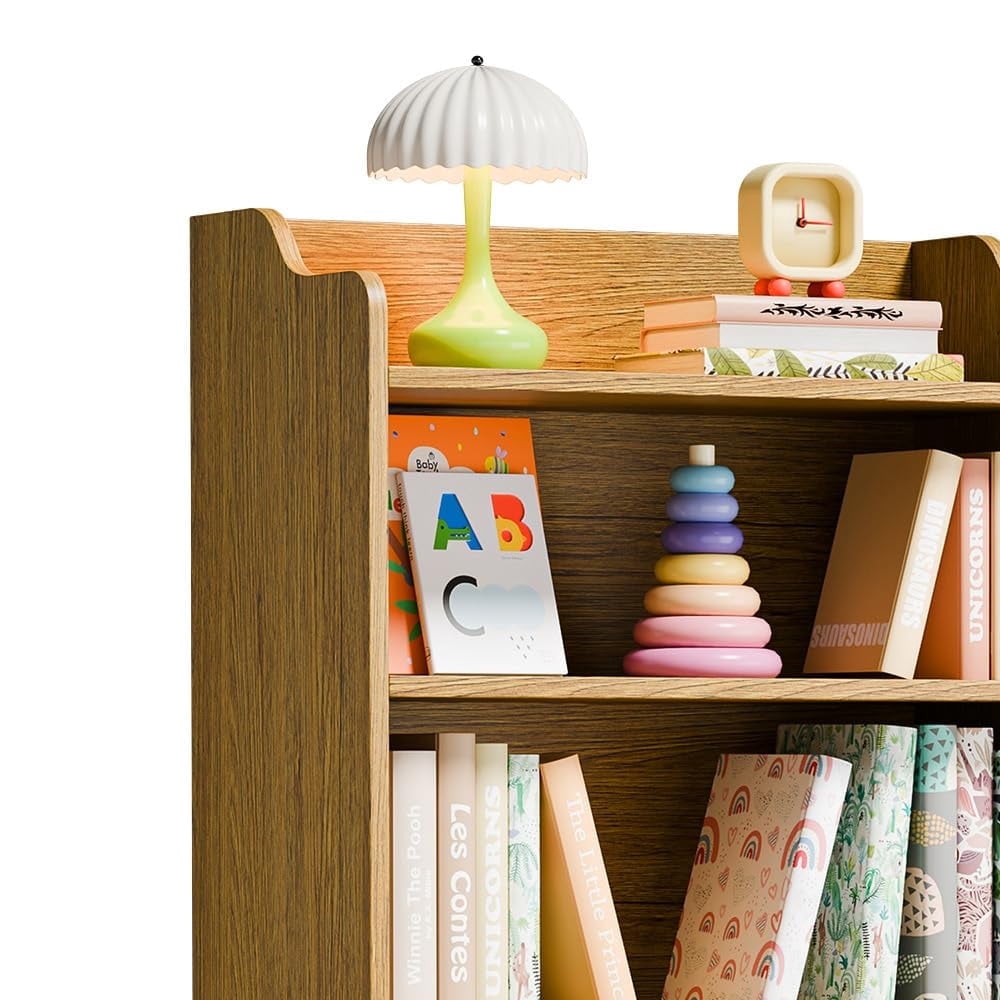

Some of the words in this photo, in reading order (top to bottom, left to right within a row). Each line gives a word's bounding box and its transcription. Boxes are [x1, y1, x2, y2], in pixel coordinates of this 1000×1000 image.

[415, 458, 439, 470] Baby
[900, 499, 948, 629] DINOSAURS
[969, 488, 985, 643] UNICORNS
[810, 622, 889, 648] DINOSAURS
[407, 805, 421, 859] Pooh
[450, 803, 471, 860] Les
[566, 792, 586, 842] The
[579, 849, 606, 921] Little
[407, 866, 421, 905] The
[485, 785, 501, 997] UNICORNS
[407, 912, 422, 985] Winnie
[450, 871, 471, 984] Contes
